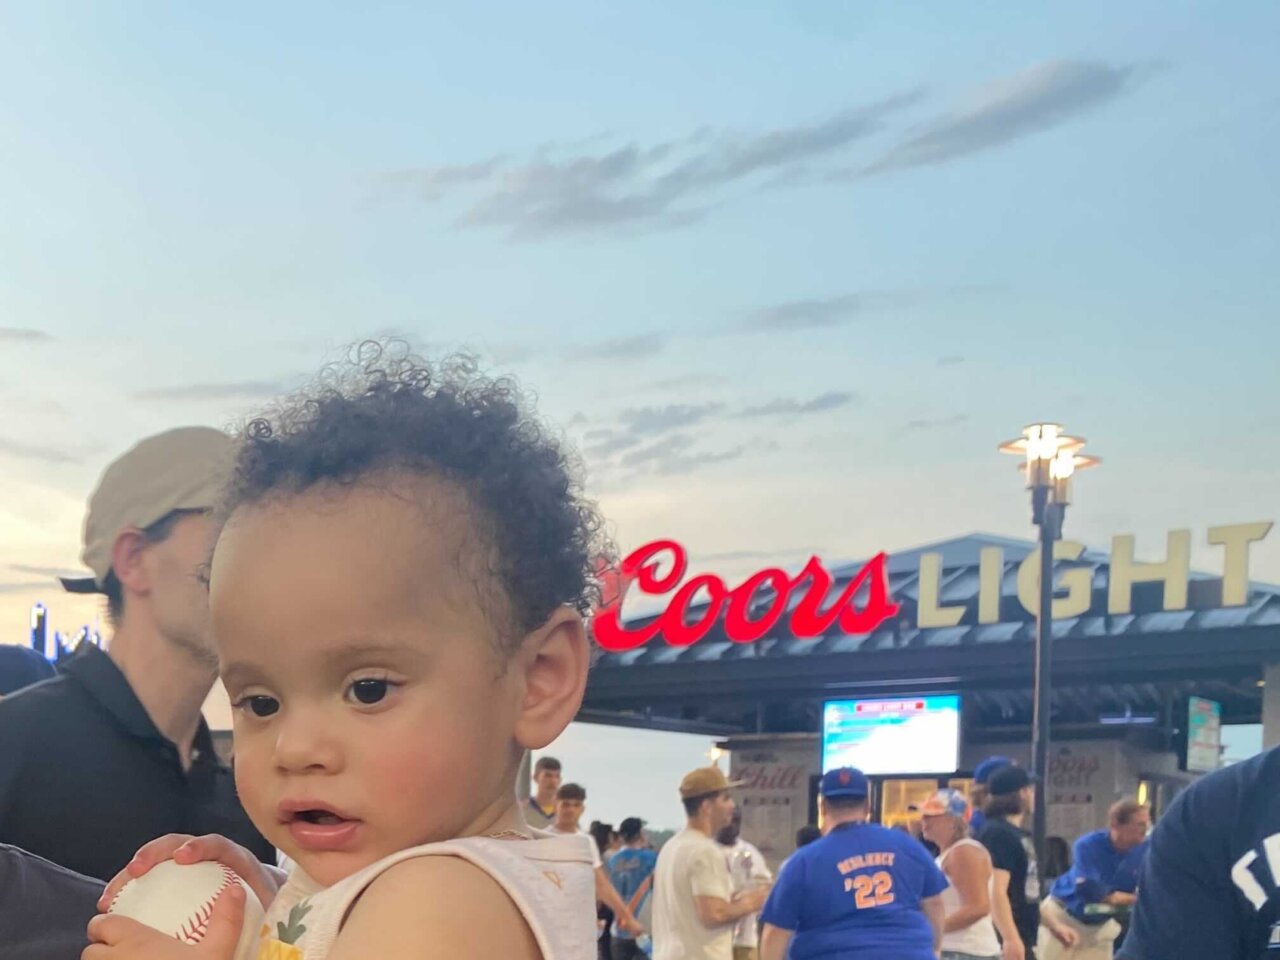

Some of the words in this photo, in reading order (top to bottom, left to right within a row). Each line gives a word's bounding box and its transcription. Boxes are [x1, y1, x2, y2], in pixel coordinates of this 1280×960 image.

[592, 539, 901, 653] Coors
[917, 521, 1274, 630] LIGHT
[844, 870, 894, 910] '22
